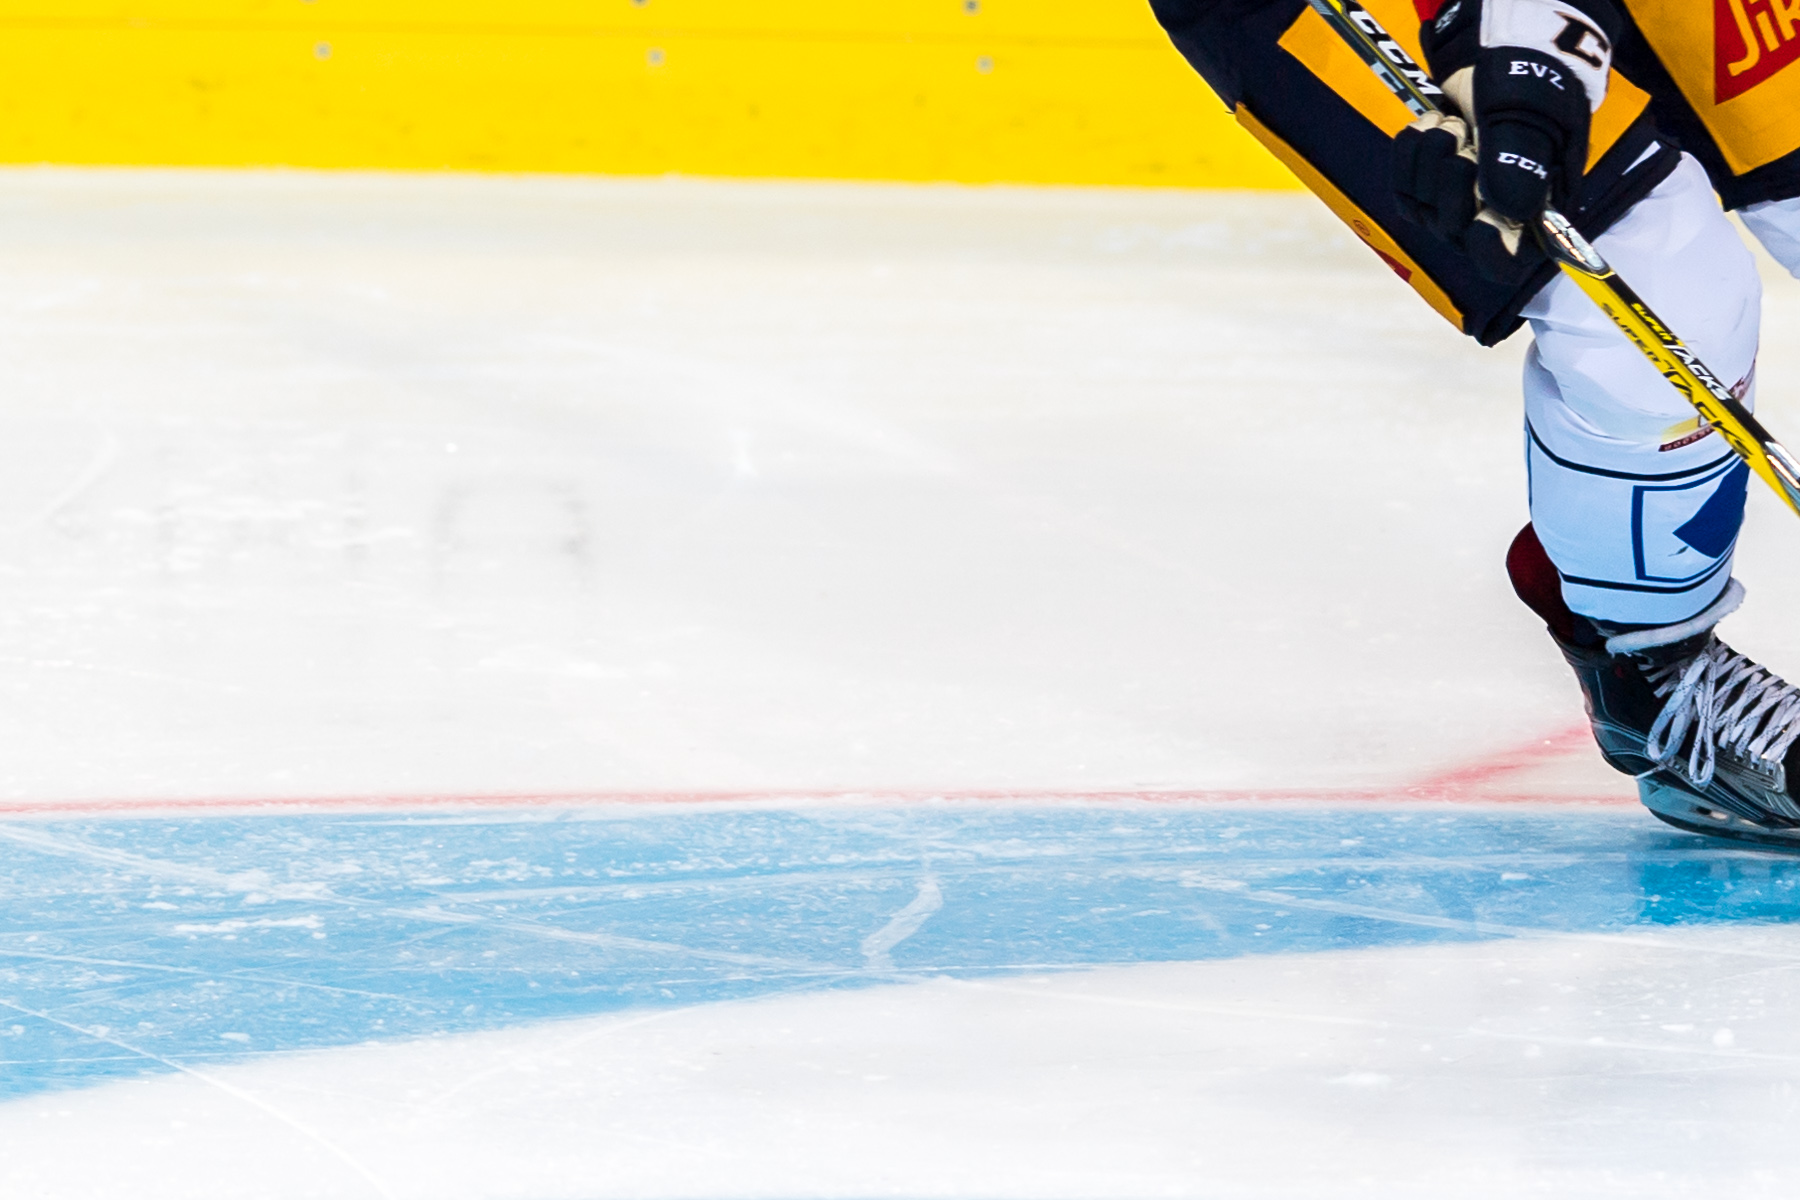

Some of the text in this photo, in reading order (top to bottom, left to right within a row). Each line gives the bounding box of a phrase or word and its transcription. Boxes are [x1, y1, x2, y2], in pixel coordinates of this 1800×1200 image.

[1349, 10, 1445, 95] CCM
[1508, 60, 1565, 91] EVZ
[1631, 302, 1673, 341] SUPER
[1662, 337, 1735, 400] TACKS
